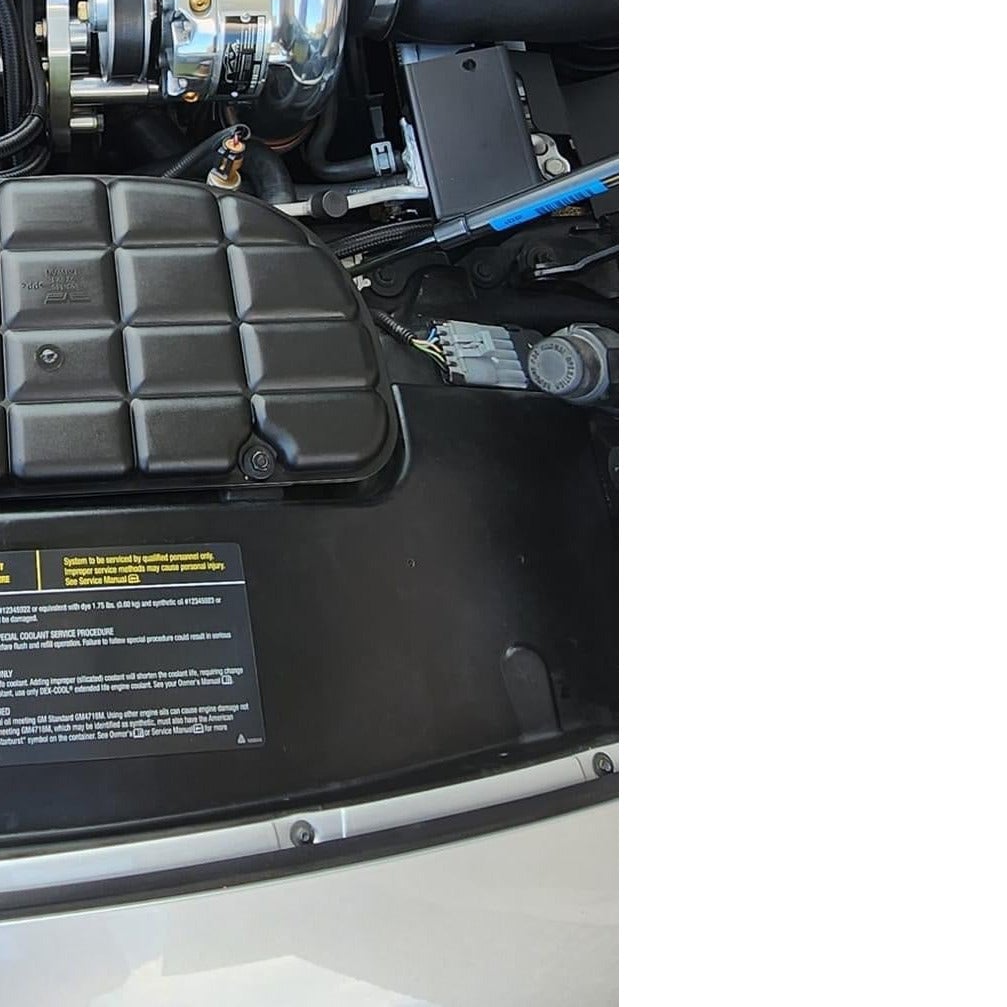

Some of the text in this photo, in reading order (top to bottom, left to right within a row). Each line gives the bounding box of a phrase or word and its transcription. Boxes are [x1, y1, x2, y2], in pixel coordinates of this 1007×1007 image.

[63, 556, 87, 565] System
[105, 555, 132, 563] serviced
[142, 553, 168, 562] qualified
[200, 552, 214, 560] only.
[63, 567, 93, 576] Improper
[118, 564, 145, 573] methods
[146, 564, 159, 573] may
[207, 562, 225, 570] injury.
[64, 574, 126, 585] See Service Manual
[19, 630, 49, 640] COOLANT
[50, 629, 75, 638] SERVICE
[77, 627, 114, 637] PROCEDURE
